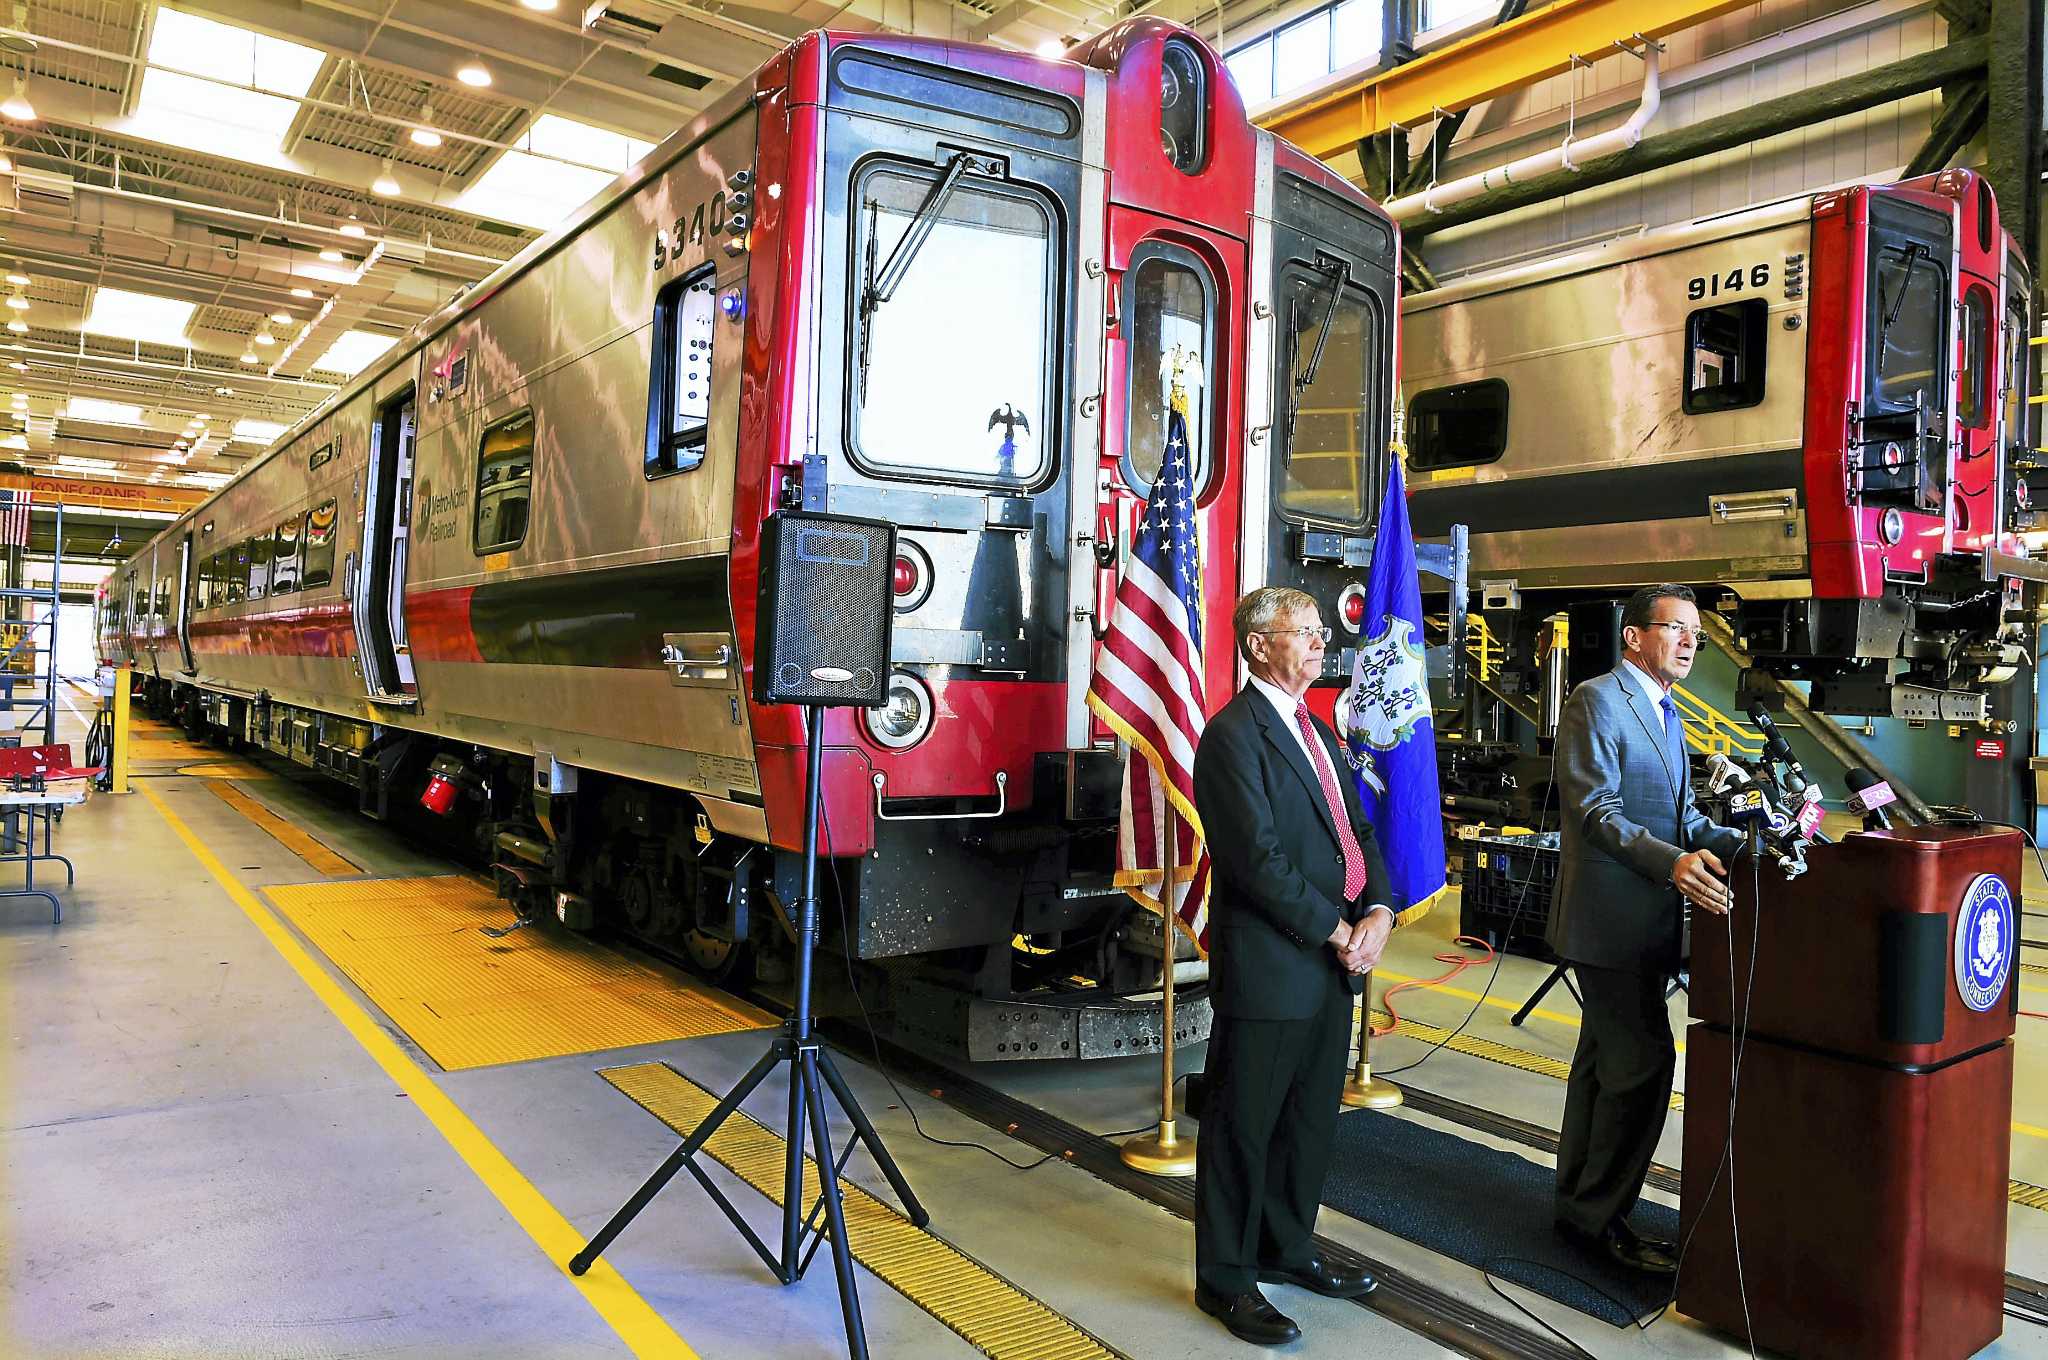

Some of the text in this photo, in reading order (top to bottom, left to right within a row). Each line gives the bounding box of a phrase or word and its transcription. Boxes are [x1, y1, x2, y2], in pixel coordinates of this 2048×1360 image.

[1687, 263, 1770, 301] 9146
[432, 484, 468, 514] Metro-North
[430, 515, 457, 542] Railroad
[1501, 772, 1519, 789] R1
[1731, 802, 1762, 815] NEWS
[1746, 789, 1762, 805] 2
[1974, 881, 2006, 907] STATE OF
[1966, 964, 2007, 1005] CONNECTICUT
